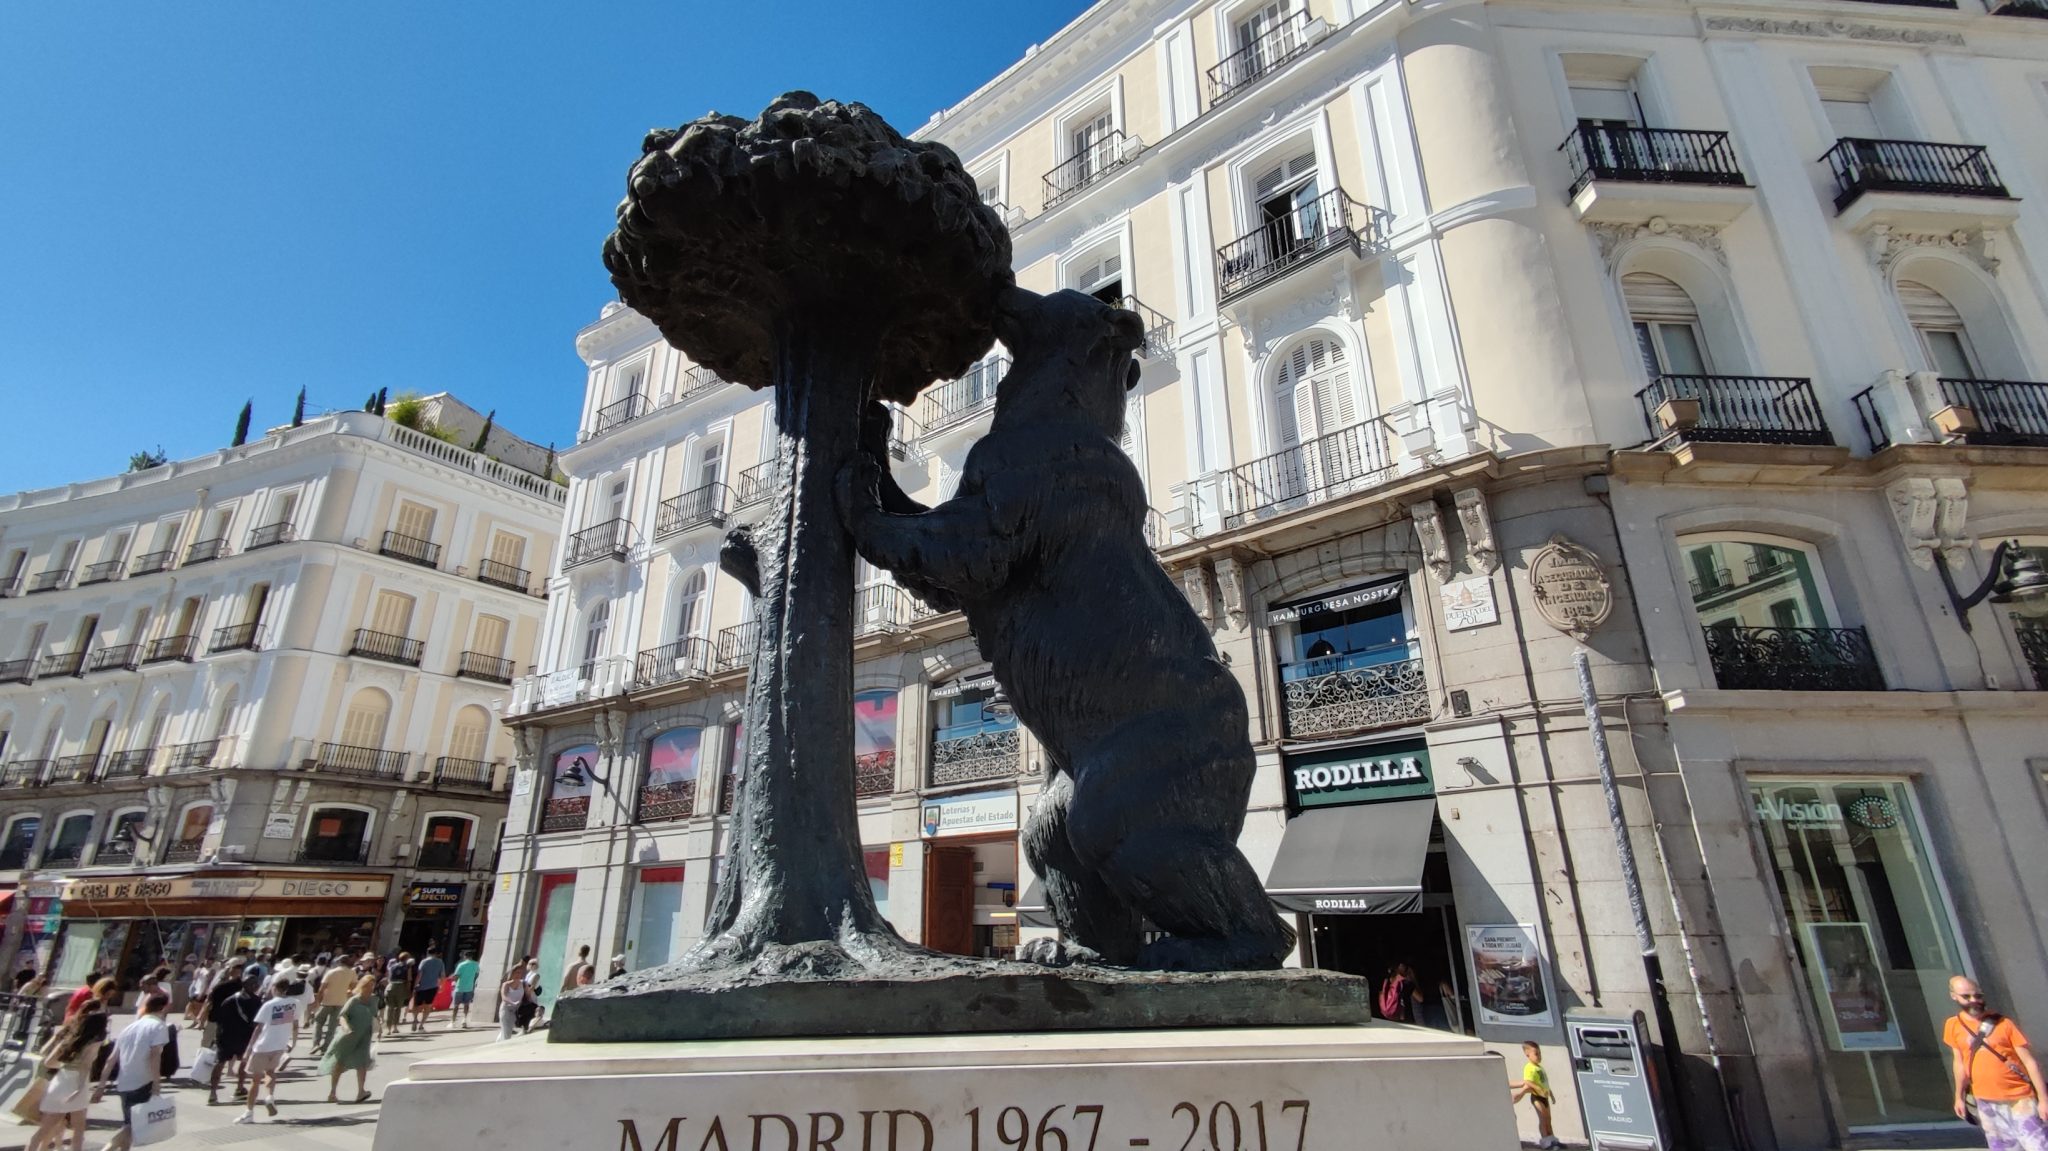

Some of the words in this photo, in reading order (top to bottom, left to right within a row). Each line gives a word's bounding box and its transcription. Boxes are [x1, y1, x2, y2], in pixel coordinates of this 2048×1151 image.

[1560, 581, 1586, 591] DE
[1272, 598, 1349, 623] HAMBURGUESA
[1353, 586, 1398, 604] NOSTRA
[1446, 608, 1479, 620] PUERTA
[1459, 615, 1483, 626] SOL
[1293, 757, 1421, 789] RODILLA
[942, 815, 974, 826] Apuestas
[975, 813, 987, 822] del
[988, 809, 1014, 821] Estado
[81, 884, 109, 898] CASA
[114, 883, 131, 897] DE
[134, 881, 172, 897] DIEGO
[282, 881, 349, 896] DIEGO
[1315, 899, 1367, 909] RODILLA
[617, 1108, 935, 1151] MADRID
[964, 1103, 1105, 1151] 1967
[1171, 1100, 1310, 1151] 2017
